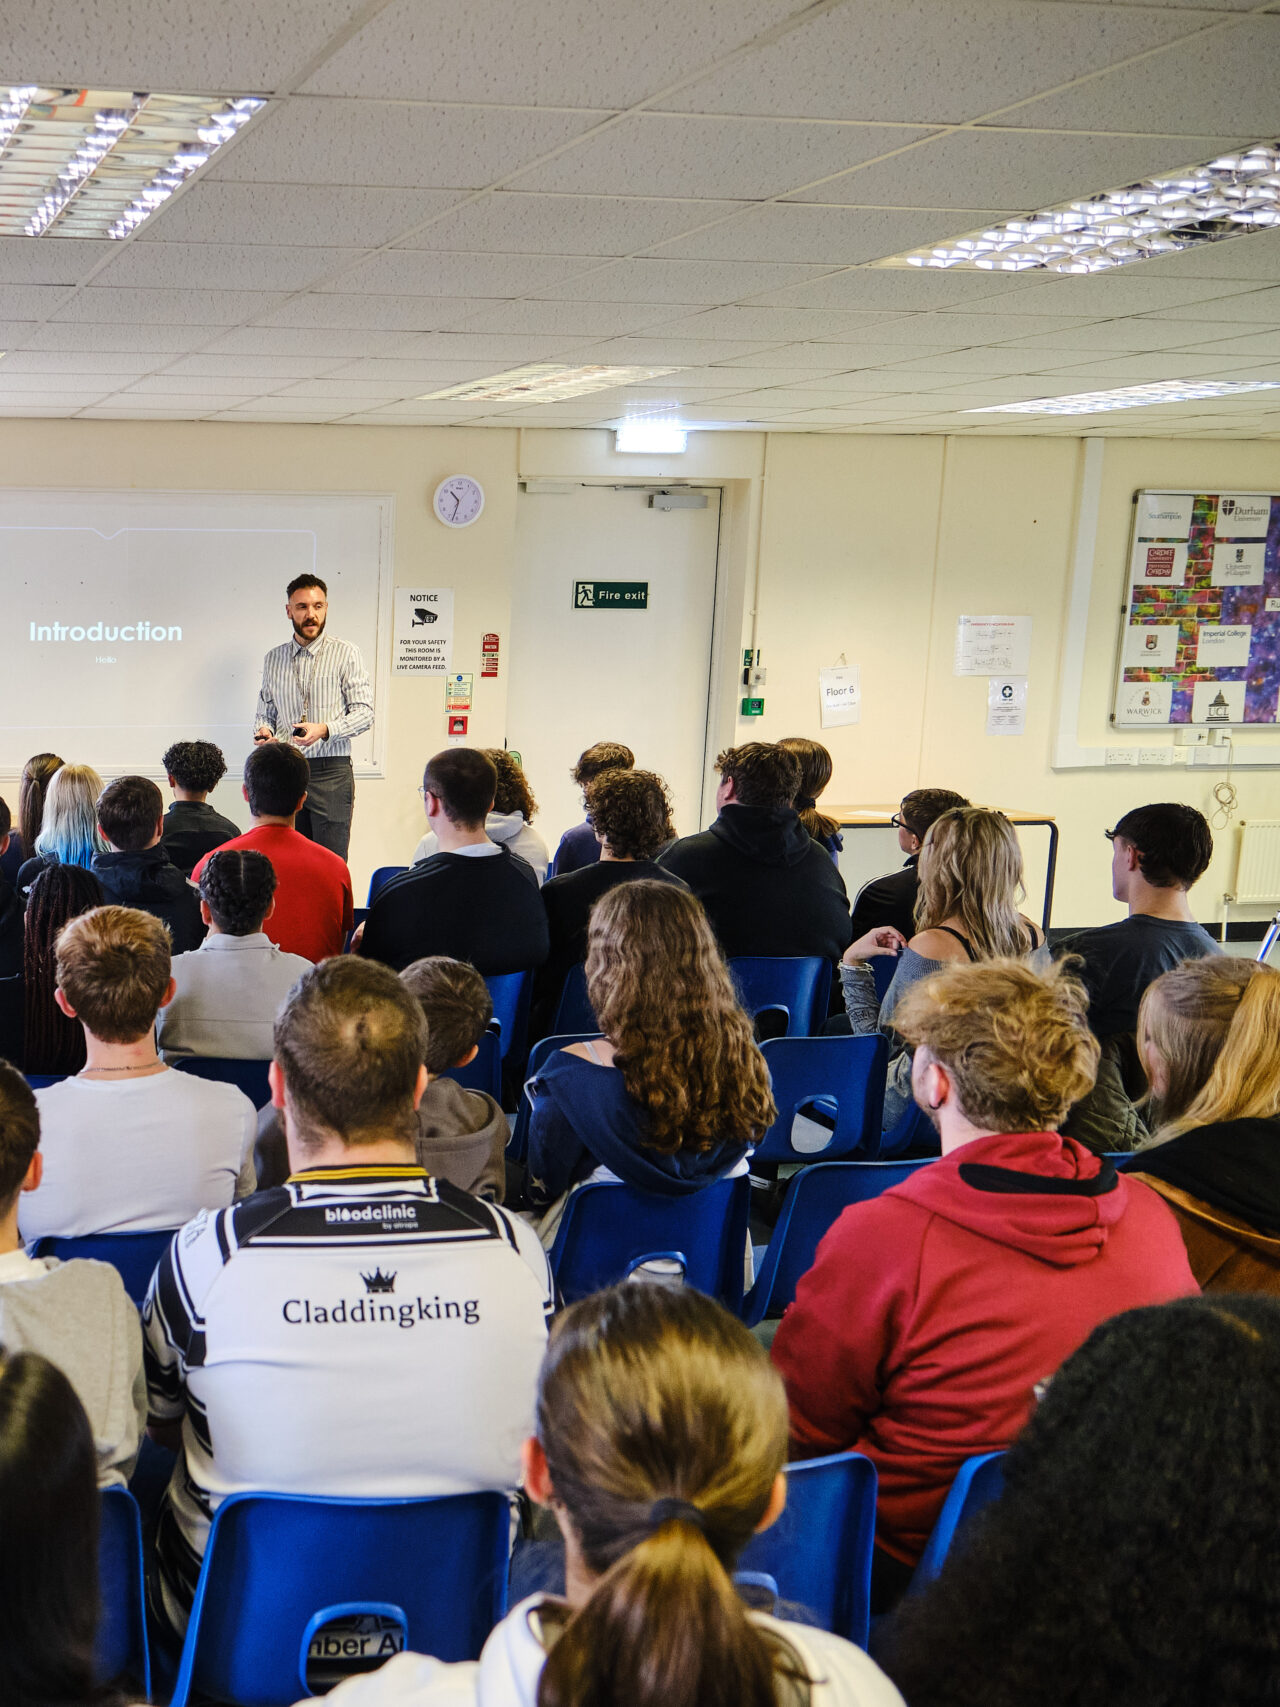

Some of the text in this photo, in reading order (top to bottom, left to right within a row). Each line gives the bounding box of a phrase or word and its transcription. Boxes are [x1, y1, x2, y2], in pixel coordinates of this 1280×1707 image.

[1235, 506, 1269, 515] Durham
[410, 594, 438, 602] NOTICE
[599, 590, 646, 600] Fire exit
[30, 621, 183, 641] Introduction
[1203, 630, 1247, 638] Imperial College
[95, 656, 117, 664] Hello
[826, 685, 855, 697] Floor 6
[1127, 708, 1162, 717] WARWICK
[1208, 707, 1229, 717] UCL
[282, 1296, 480, 1328] Claddingking
